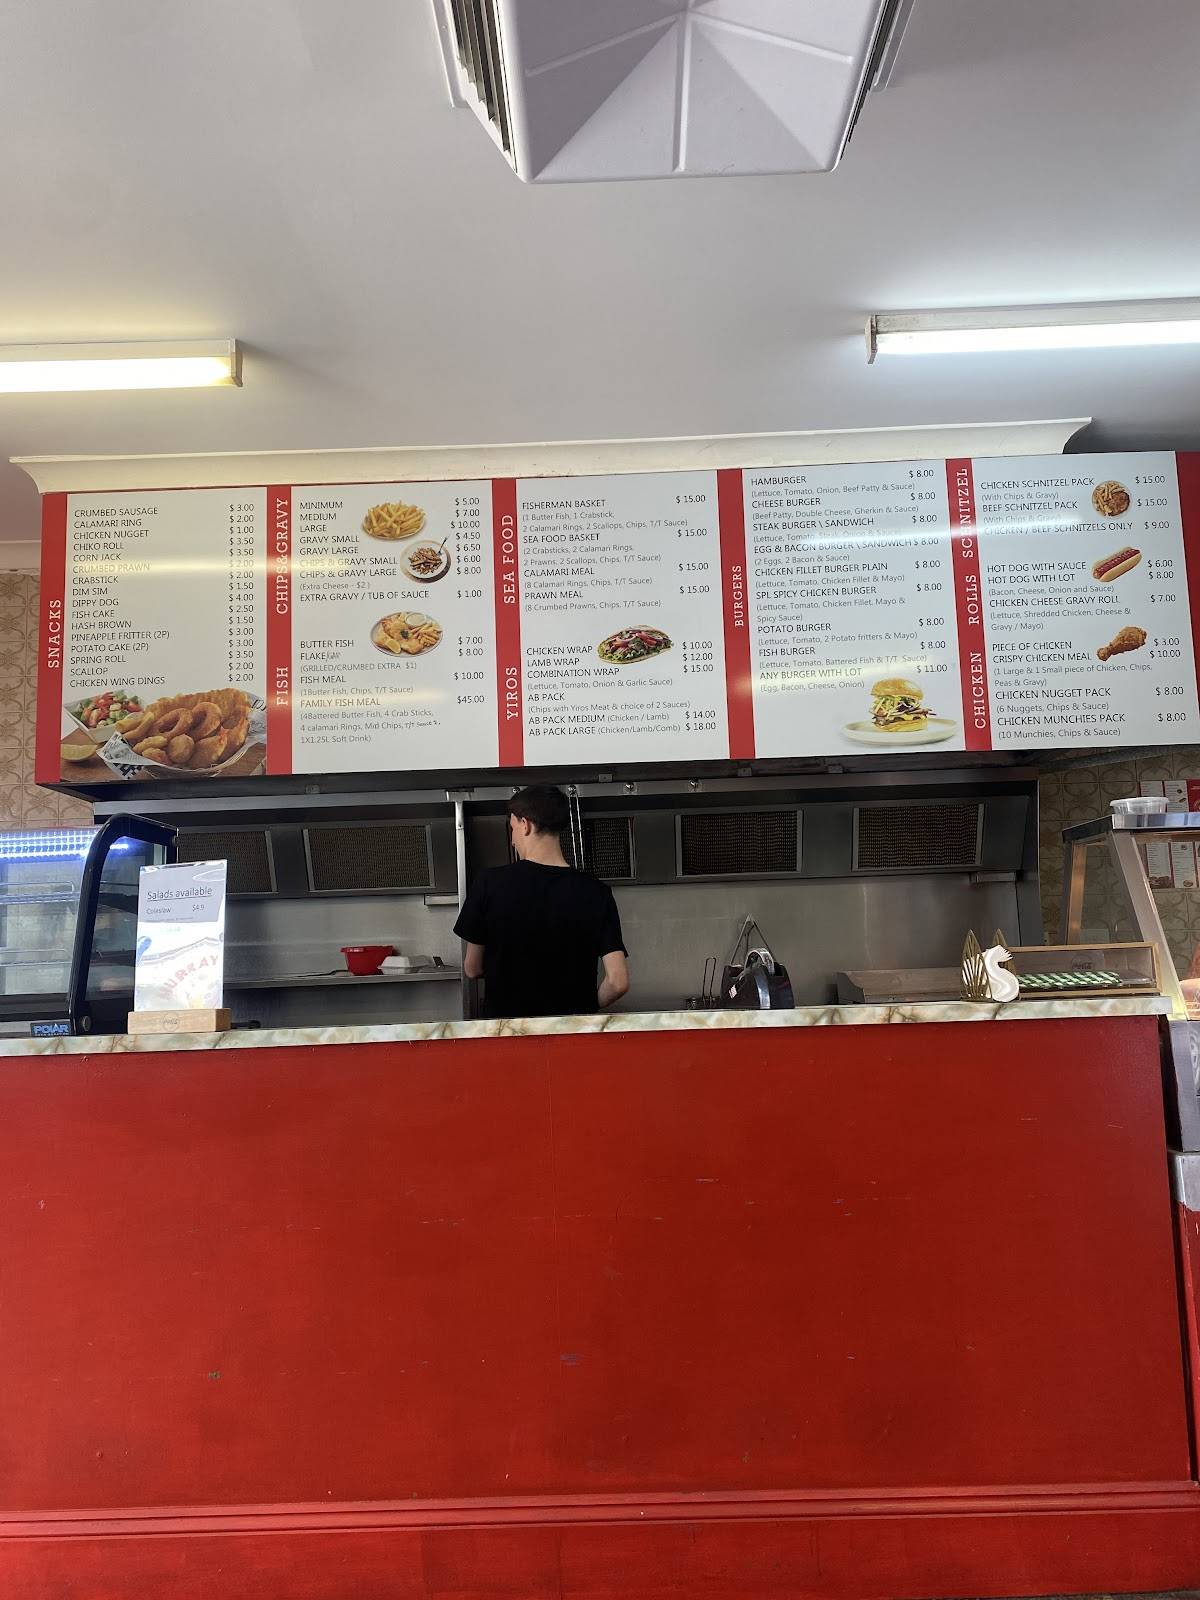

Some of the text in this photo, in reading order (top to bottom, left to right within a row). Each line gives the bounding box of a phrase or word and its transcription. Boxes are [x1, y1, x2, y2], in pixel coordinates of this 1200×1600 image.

[908, 470, 934, 478] $ 8.00
[751, 476, 806, 485] HAMBURGER
[980, 478, 1094, 490] CHICKEN SCHNITZEL PACK
[1142, 476, 1165, 484] 15.00
[462, 497, 479, 505] 5.00
[683, 495, 705, 503] 15.00
[751, 498, 820, 508] CHEESE BURGER
[236, 504, 254, 512] 3.00
[299, 501, 342, 509] MINIMUM
[522, 499, 605, 510] FISHERMAN BASKET
[982, 501, 1078, 512] BEEF SCHNITZEL PACK
[74, 507, 158, 517] CRUMBED SAUSAGE
[299, 512, 336, 521] MEDIUM
[73, 519, 141, 529] CALAMARI RING
[299, 524, 326, 533] LARGE
[73, 530, 149, 540] CHICKEN NUGGET
[299, 534, 359, 544] GRAVY SMALL
[522, 533, 599, 543] SEA FOOD BASKET
[73, 542, 123, 551] CHIKO ROLL
[299, 546, 358, 555] GRAVY LARGE
[72, 553, 121, 562] CORN JACK
[276, 498, 288, 615] CHIPS&GRAVY
[502, 514, 516, 604] SEA FOOD
[523, 567, 594, 577] CALAMARI MEAL
[754, 563, 887, 576] CHICKEN FILLET BURGER PLAIN
[987, 562, 1086, 572] HOT DOG WITH SAUCE
[72, 576, 118, 585] CRABSTICK
[987, 574, 1075, 584] HOT DOG WITH LOT
[72, 588, 107, 596] DIM SIM
[524, 590, 583, 600] PRAWN MEAL
[732, 566, 744, 628] BURGERS
[755, 586, 876, 599] SPL SPICY CHICKEN BURGER
[72, 598, 118, 607] DIPPY DOG
[966, 574, 980, 624] ROLLS
[989, 596, 1120, 607] CHICKEN CHEESE GRAVY ROLL
[71, 610, 114, 618] FISH CAKE
[71, 620, 131, 630] HASH BROWN
[757, 623, 831, 633] POTATO BURGER
[48, 600, 61, 668] SNACKS
[71, 631, 169, 641] PINEAPPLE FRITTER (2P)
[71, 643, 148, 652] POTATO CAKE (2P)
[300, 639, 353, 648] BUTTER FISH
[992, 641, 1071, 651] PIECE OF CHICKEN
[526, 646, 592, 655] CHICKEN WRAP
[758, 647, 815, 656] FISH BURGER
[70, 655, 126, 664] SPRING ROLL
[300, 652, 326, 660] FLAKE
[992, 653, 1091, 663] CRISPY CHICKEN MEAL
[527, 657, 579, 666] LAMB WRAP
[70, 667, 110, 675] SCALLOP
[527, 667, 619, 678] COMBINATION WRAP
[69, 677, 165, 687] CHICKEN WING DINGS
[300, 675, 346, 684] FISH MEAL
[276, 666, 288, 706] FISH
[970, 652, 986, 729] CHICKEN
[506, 666, 519, 720] YIROS
[527, 692, 565, 701] AB PACK
[995, 688, 1111, 699] CHICKEN NUGGET PACK
[996, 704, 1006, 714] (6
[1006, 704, 1044, 713] Nuggets,
[1046, 703, 1069, 712] Chips
[1081, 702, 1109, 712] Sauce)
[528, 716, 540, 724] AB
[542, 715, 565, 724] PACK
[568, 714, 604, 723] MEDIUM
[607, 714, 638, 723] (Chicken
[646, 713, 669, 722] Lamb)
[997, 714, 1125, 725] CHICKEN MUNCHIES PACK
[528, 728, 540, 736] AB
[543, 727, 566, 736] PACK
[568, 726, 595, 735] LARGE
[998, 731, 1011, 740] (10
[1013, 730, 1055, 739] Munchies,
[1057, 729, 1081, 739] Chips
[1092, 729, 1120, 738] Sauce)
[147, 886, 213, 900] Salads available
